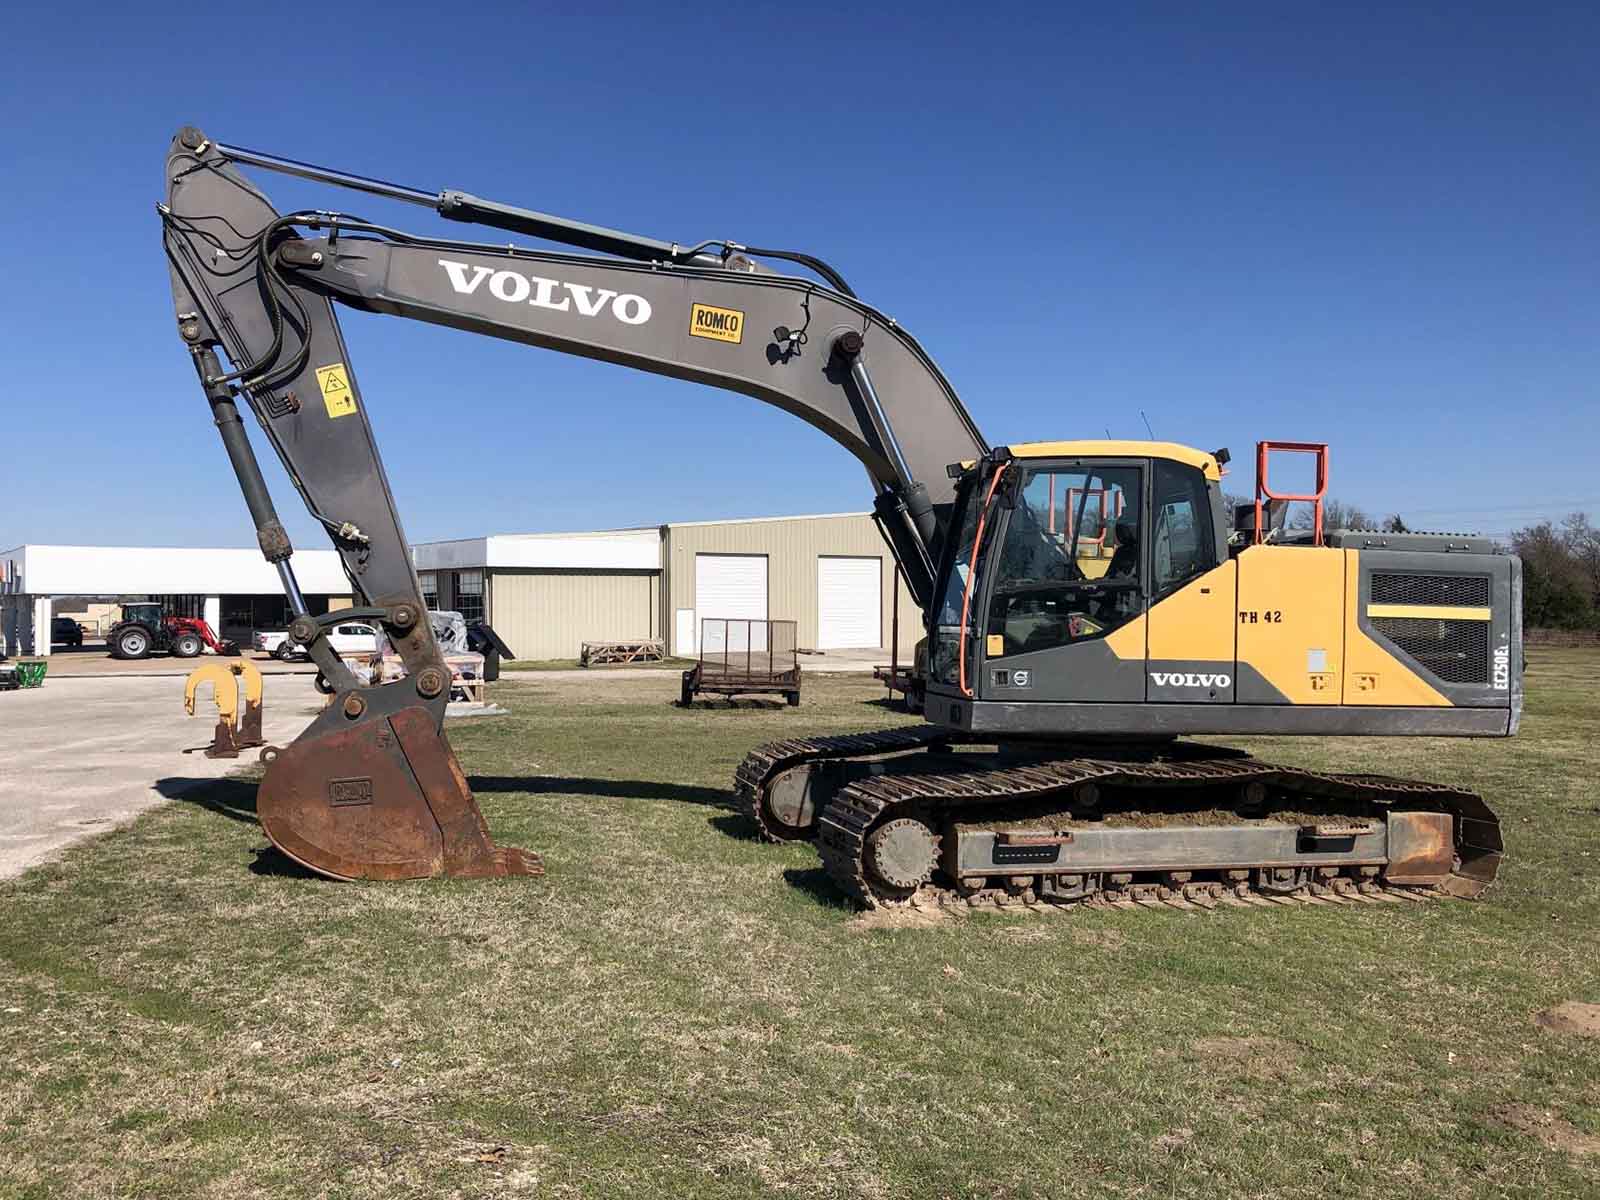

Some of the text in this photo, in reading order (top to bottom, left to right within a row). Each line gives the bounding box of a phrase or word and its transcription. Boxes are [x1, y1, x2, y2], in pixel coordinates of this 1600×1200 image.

[438, 259, 652, 325] VOLVO
[696, 309, 738, 332] ROMCO
[1239, 611, 1282, 624] TH 42
[1150, 672, 1231, 688] VOLVO
